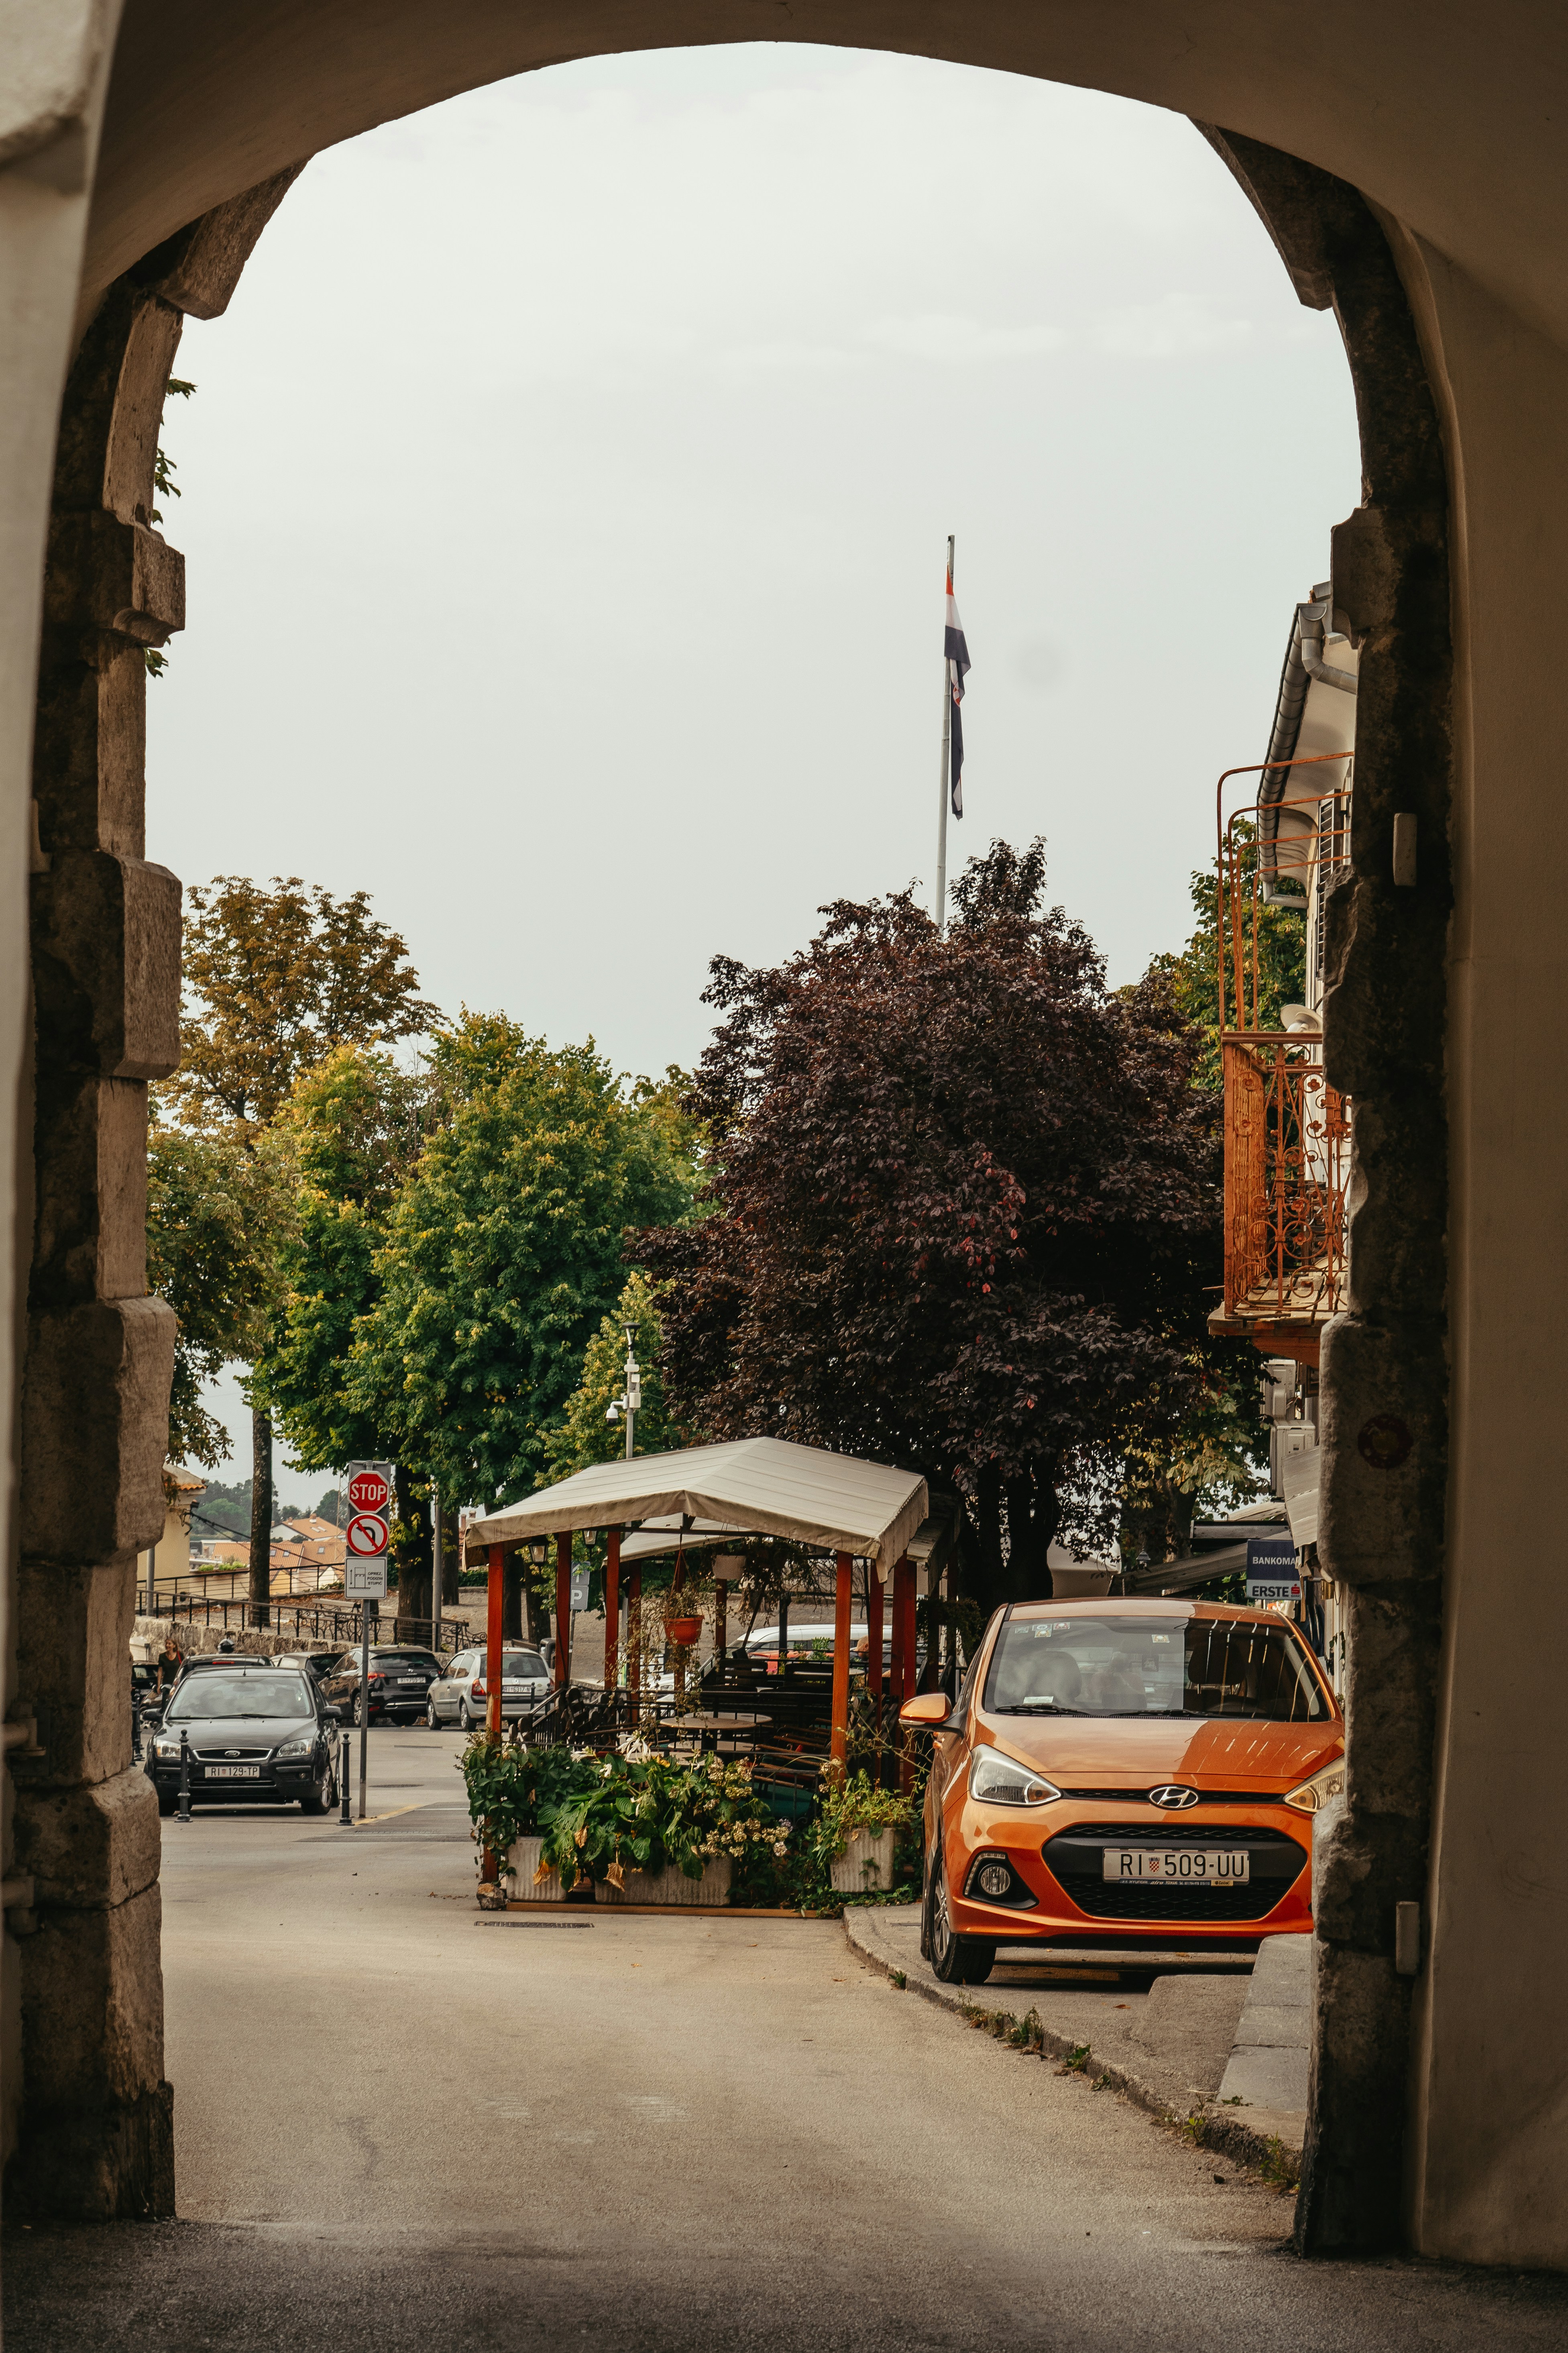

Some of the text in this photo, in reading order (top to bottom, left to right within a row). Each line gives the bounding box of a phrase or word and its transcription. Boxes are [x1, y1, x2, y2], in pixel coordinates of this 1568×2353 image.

[350, 1483, 386, 1501] STOP
[1252, 1557, 1296, 1565] BANKOMA
[570, 1590, 582, 1605] P
[1252, 1586, 1289, 1597] ERSTE
[211, 1767, 258, 1776] RI 129-TP
[1121, 1853, 1244, 1877] RI 509-UU
